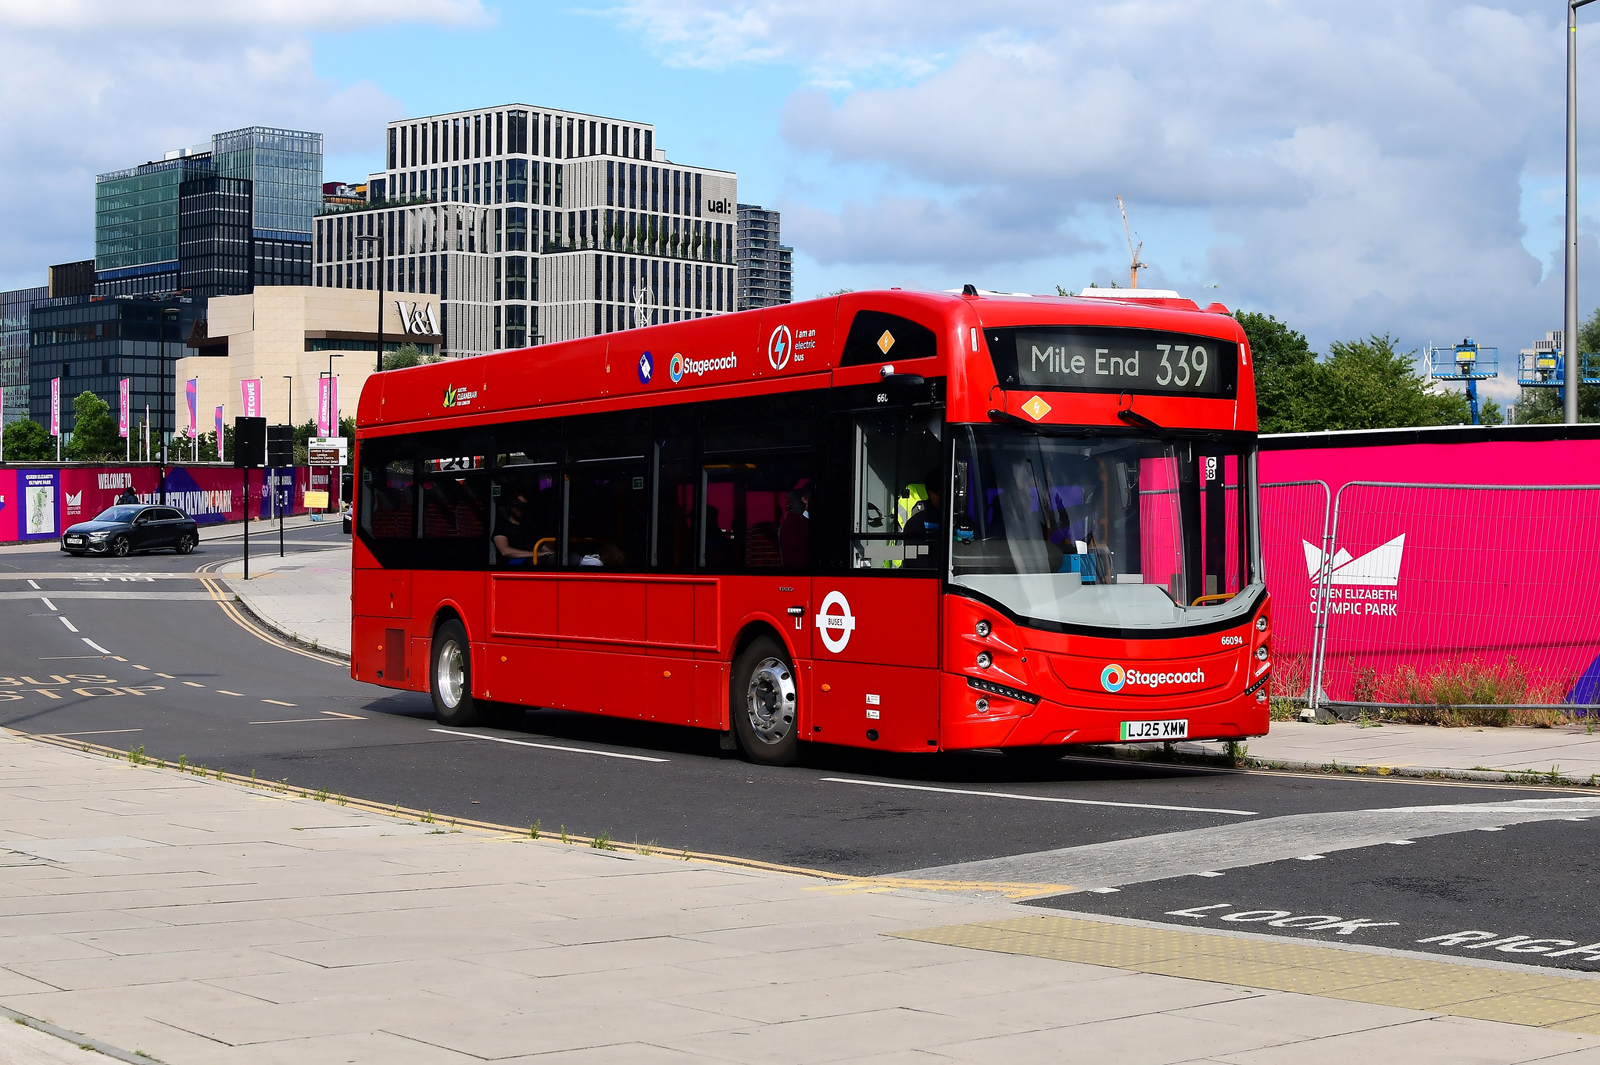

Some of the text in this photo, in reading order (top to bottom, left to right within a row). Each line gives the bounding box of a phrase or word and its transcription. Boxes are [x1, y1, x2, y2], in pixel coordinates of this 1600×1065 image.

[394, 301, 443, 336] V&A
[795, 330, 799, 338] I
[808, 329, 816, 337] an
[794, 340, 816, 350] electric
[684, 351, 737, 376] Stagecoach
[794, 353, 804, 362] bus
[1031, 344, 1209, 386] Mile End 339
[1205, 457, 1216, 469] C
[97, 473, 132, 489] WELCOME TO
[185, 490, 215, 515] OLYMPIC
[215, 490, 232, 513] PARK
[1310, 588, 1397, 600] QEN ELIZABETH
[1310, 601, 1397, 616] OYMPIC PARK
[828, 618, 843, 626] BUSES
[1221, 636, 1243, 645] 66094
[1126, 667, 1205, 688] Stagecoach
[1128, 721, 1186, 737] LJ25 XMW
[1163, 903, 1399, 934] LOOK
